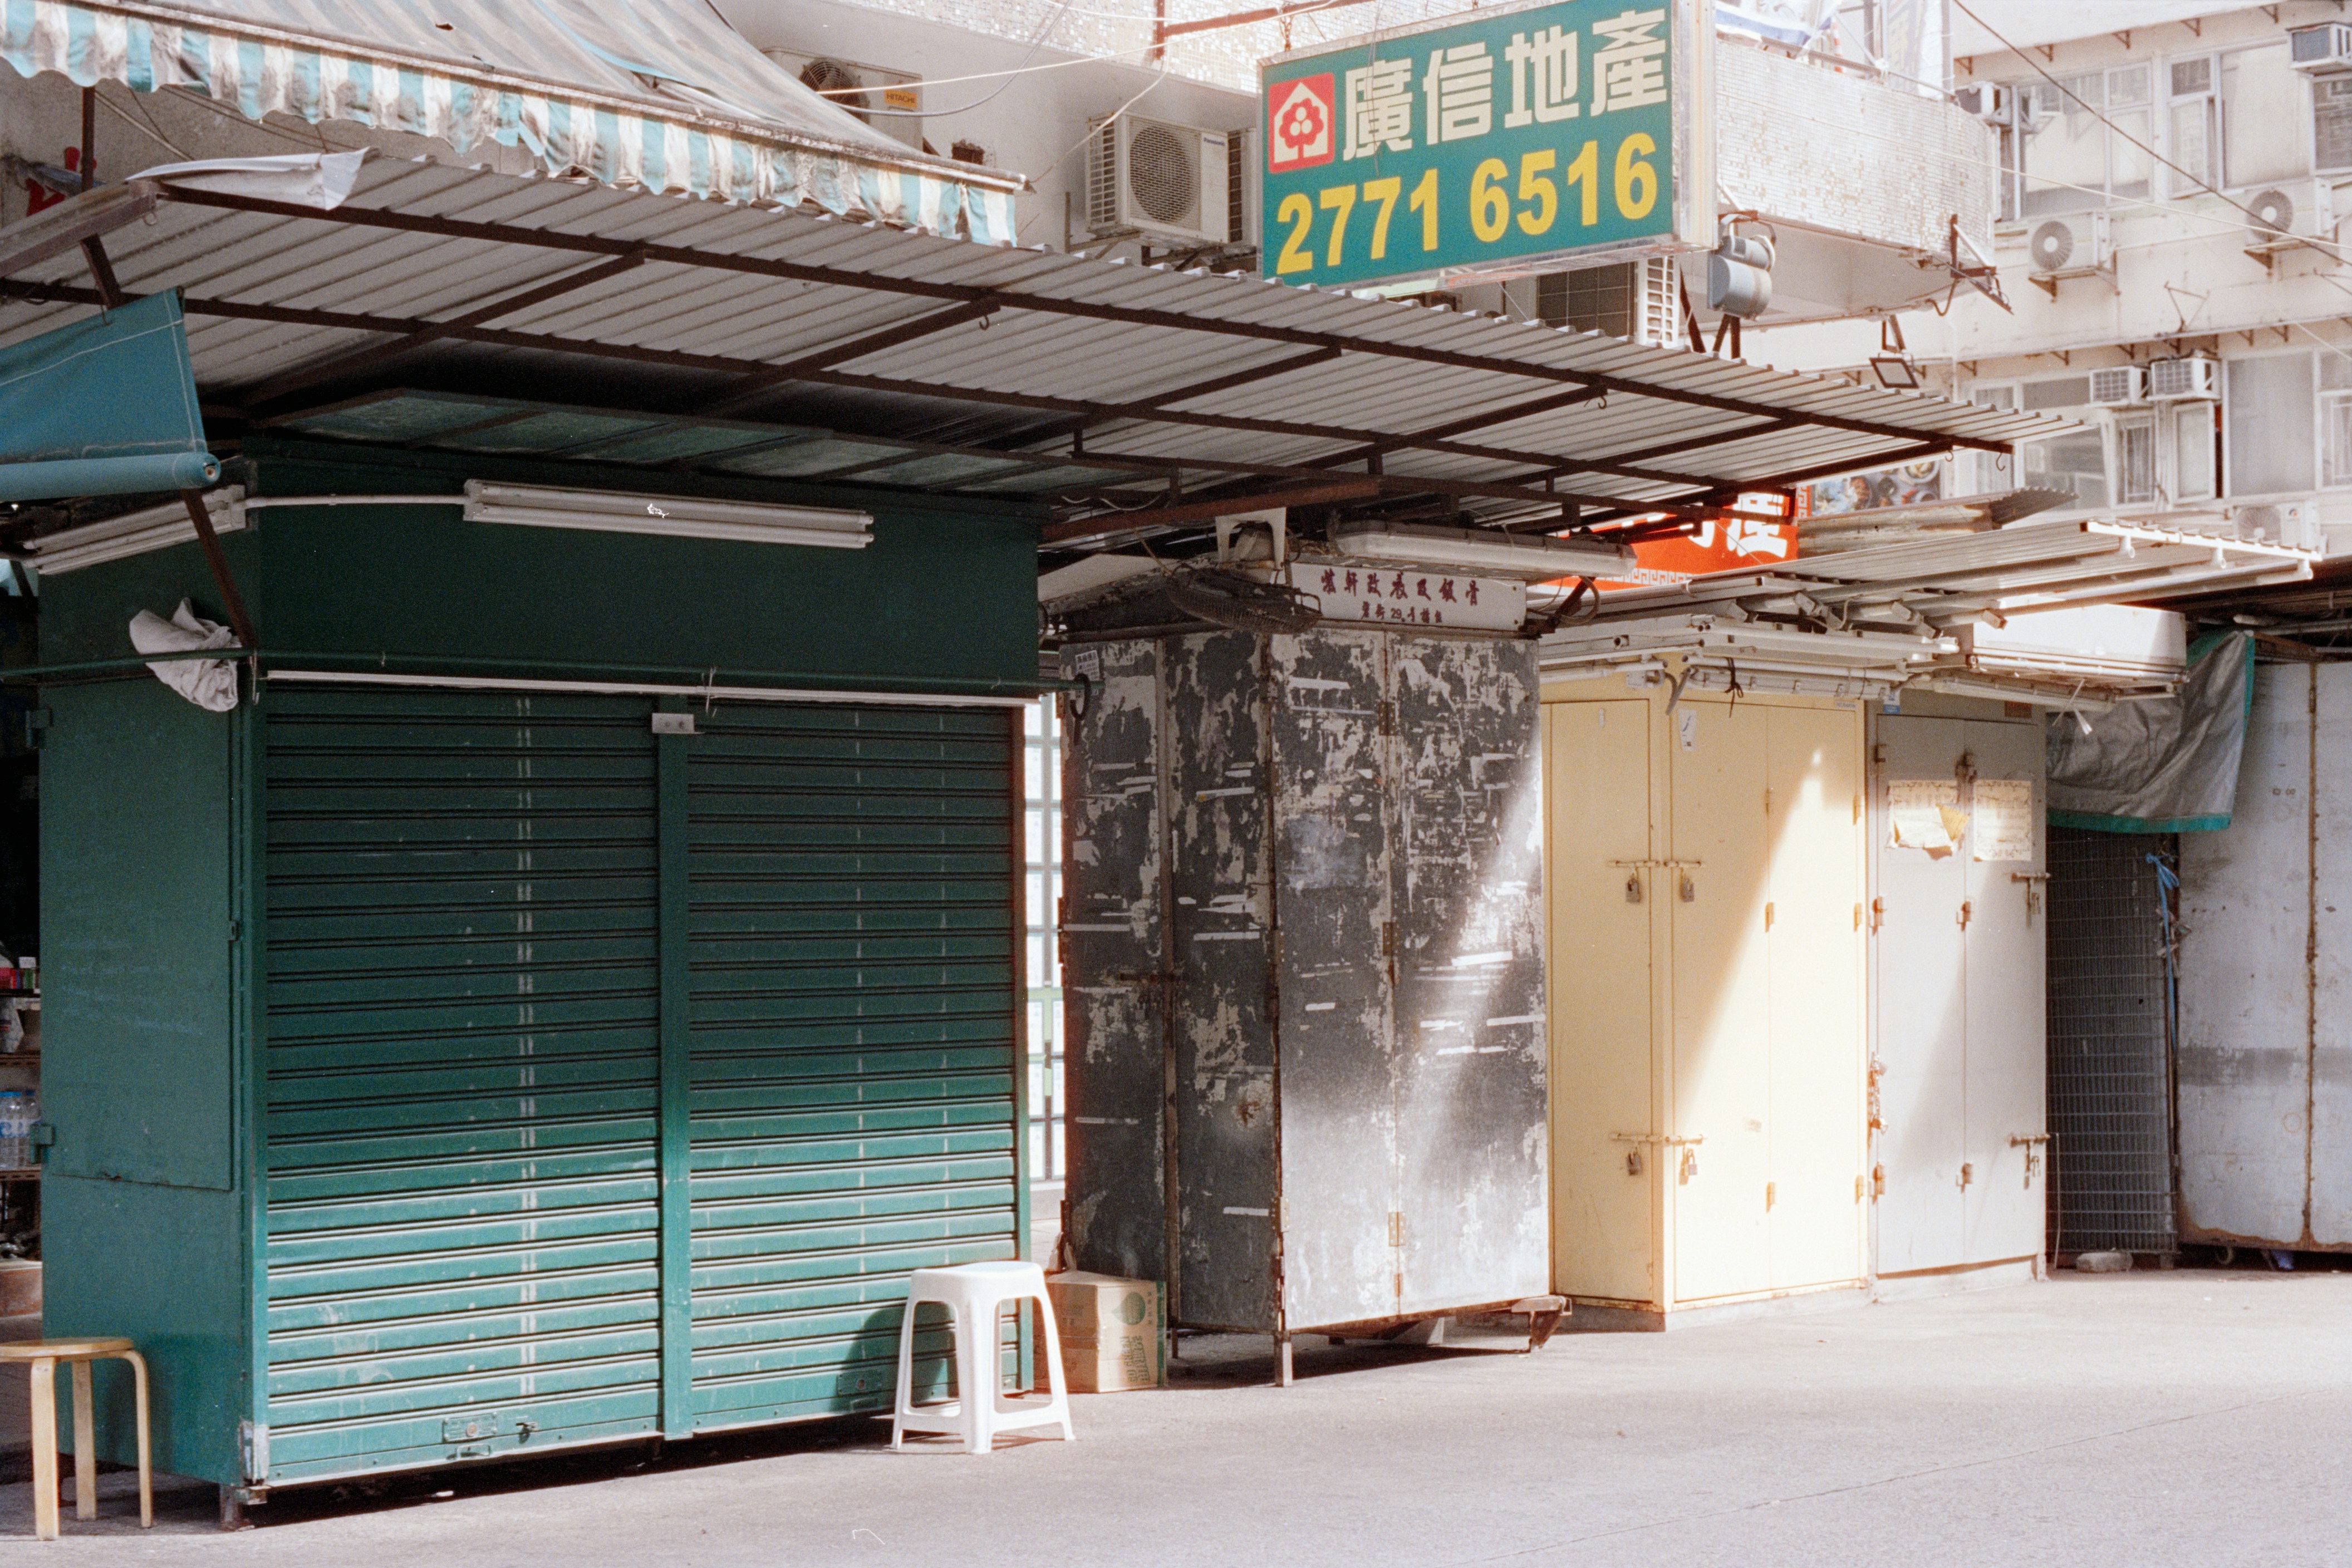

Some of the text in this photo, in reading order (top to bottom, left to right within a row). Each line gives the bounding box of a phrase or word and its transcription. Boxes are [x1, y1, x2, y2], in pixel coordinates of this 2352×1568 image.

[887, 93, 915, 104] HITACHI
[1343, 8, 1668, 161] 廣信地產
[1276, 132, 1658, 274] 2771 6516
